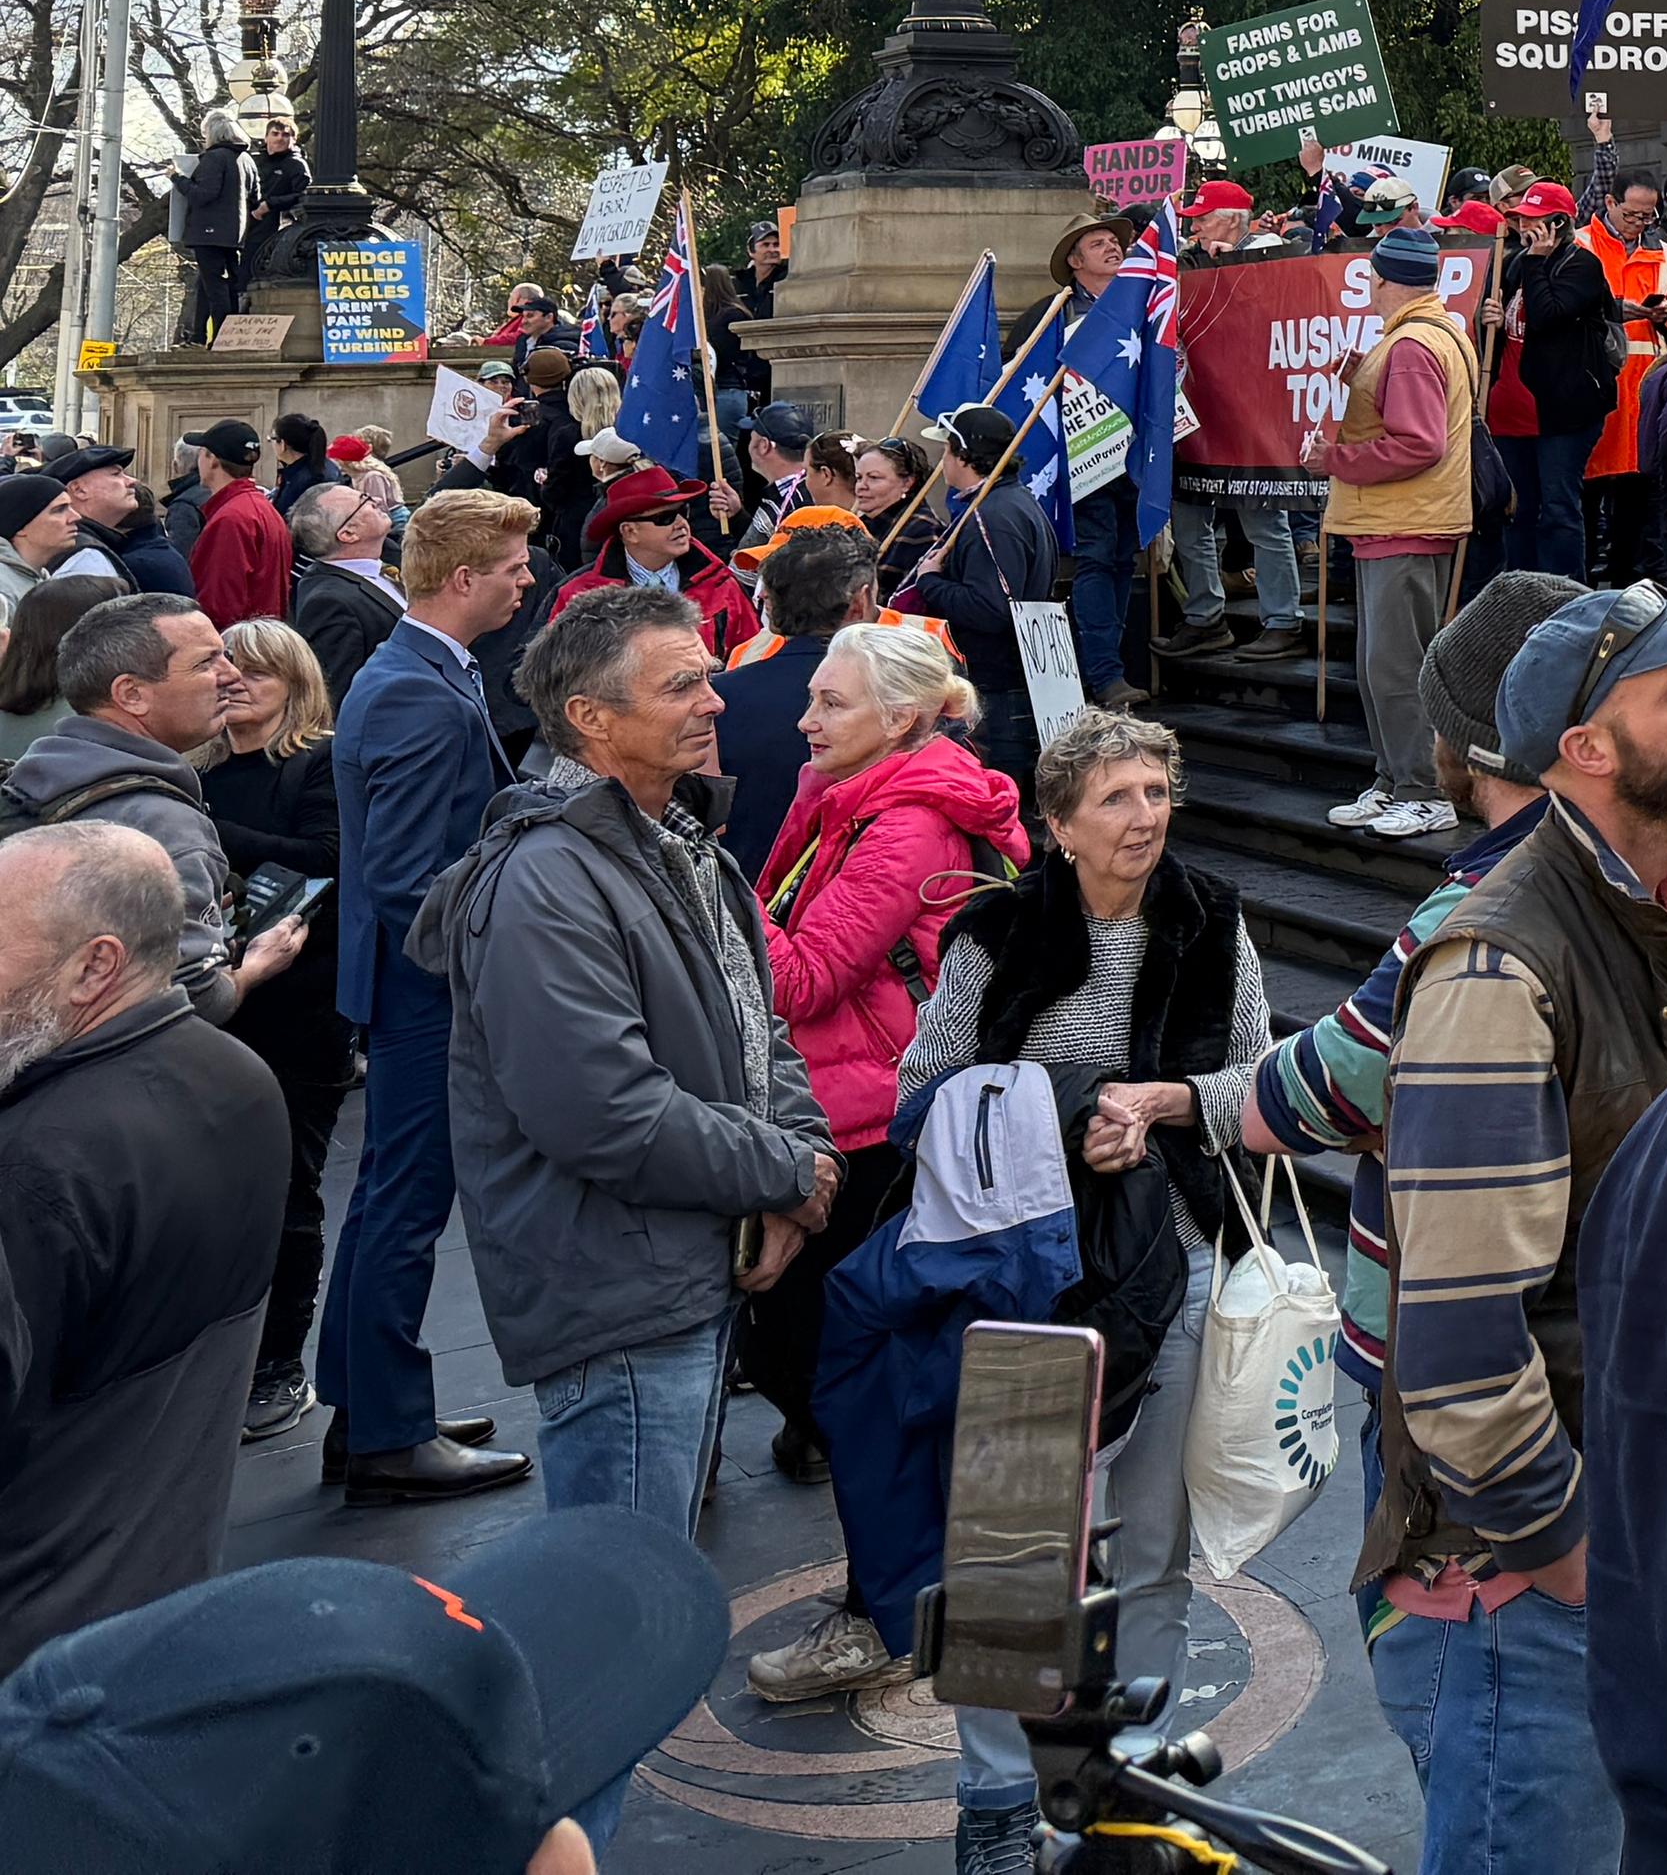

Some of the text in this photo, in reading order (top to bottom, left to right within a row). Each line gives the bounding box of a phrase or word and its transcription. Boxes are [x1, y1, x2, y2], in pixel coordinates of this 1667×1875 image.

[1226, 9, 1339, 55] FARMS FOR
[1516, 9, 1578, 37] PIS
[1216, 28, 1363, 82] CROPS & LAMB
[1227, 63, 1368, 115] NOT TWIGGY'S
[1229, 85, 1378, 138] TURBINE SCAM
[1091, 143, 1176, 174] HANDS
[1357, 143, 1413, 168] MINES
[1128, 173, 1172, 195] OUR
[321, 250, 407, 266] WEDGE
[322, 268, 403, 283] TAILED
[1340, 256, 1473, 309] SP
[325, 284, 410, 300] EAGLES
[325, 301, 389, 314] AREN'T
[326, 315, 372, 327] FANS
[327, 328, 406, 341] OF WIND
[327, 340, 420, 354] TURBINES!
[1065, 414, 1087, 437] HE
[1018, 617, 1047, 679] NO
